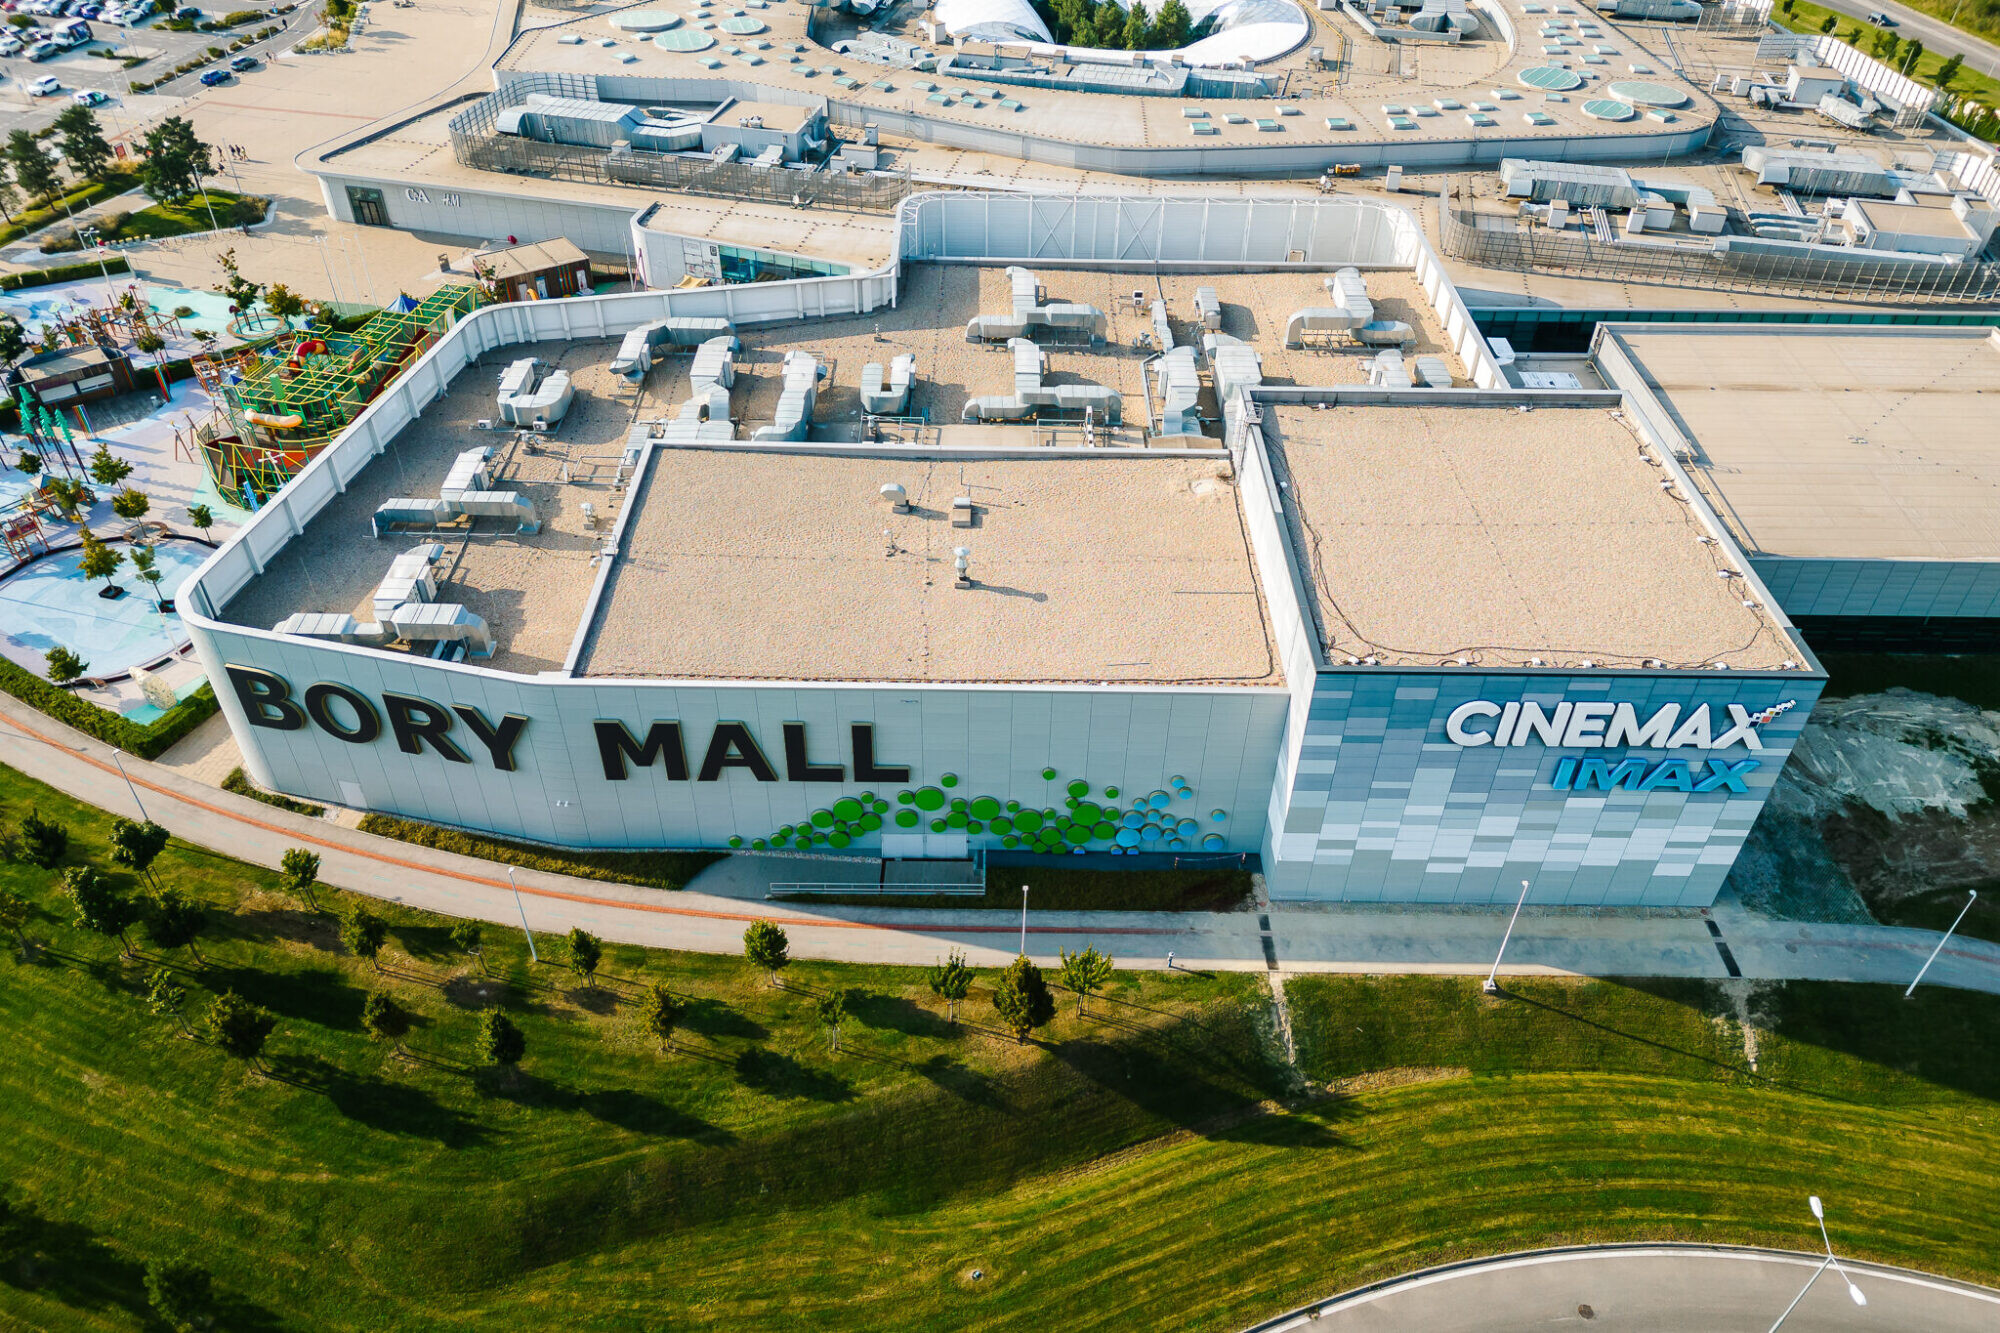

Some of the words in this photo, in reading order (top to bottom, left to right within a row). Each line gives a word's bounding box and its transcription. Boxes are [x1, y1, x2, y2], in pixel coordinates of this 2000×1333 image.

[225, 663, 529, 772] BORY
[593, 719, 910, 783] MALL
[1446, 699, 1764, 750] CINEMAX
[1552, 757, 1761, 793] IMAX
